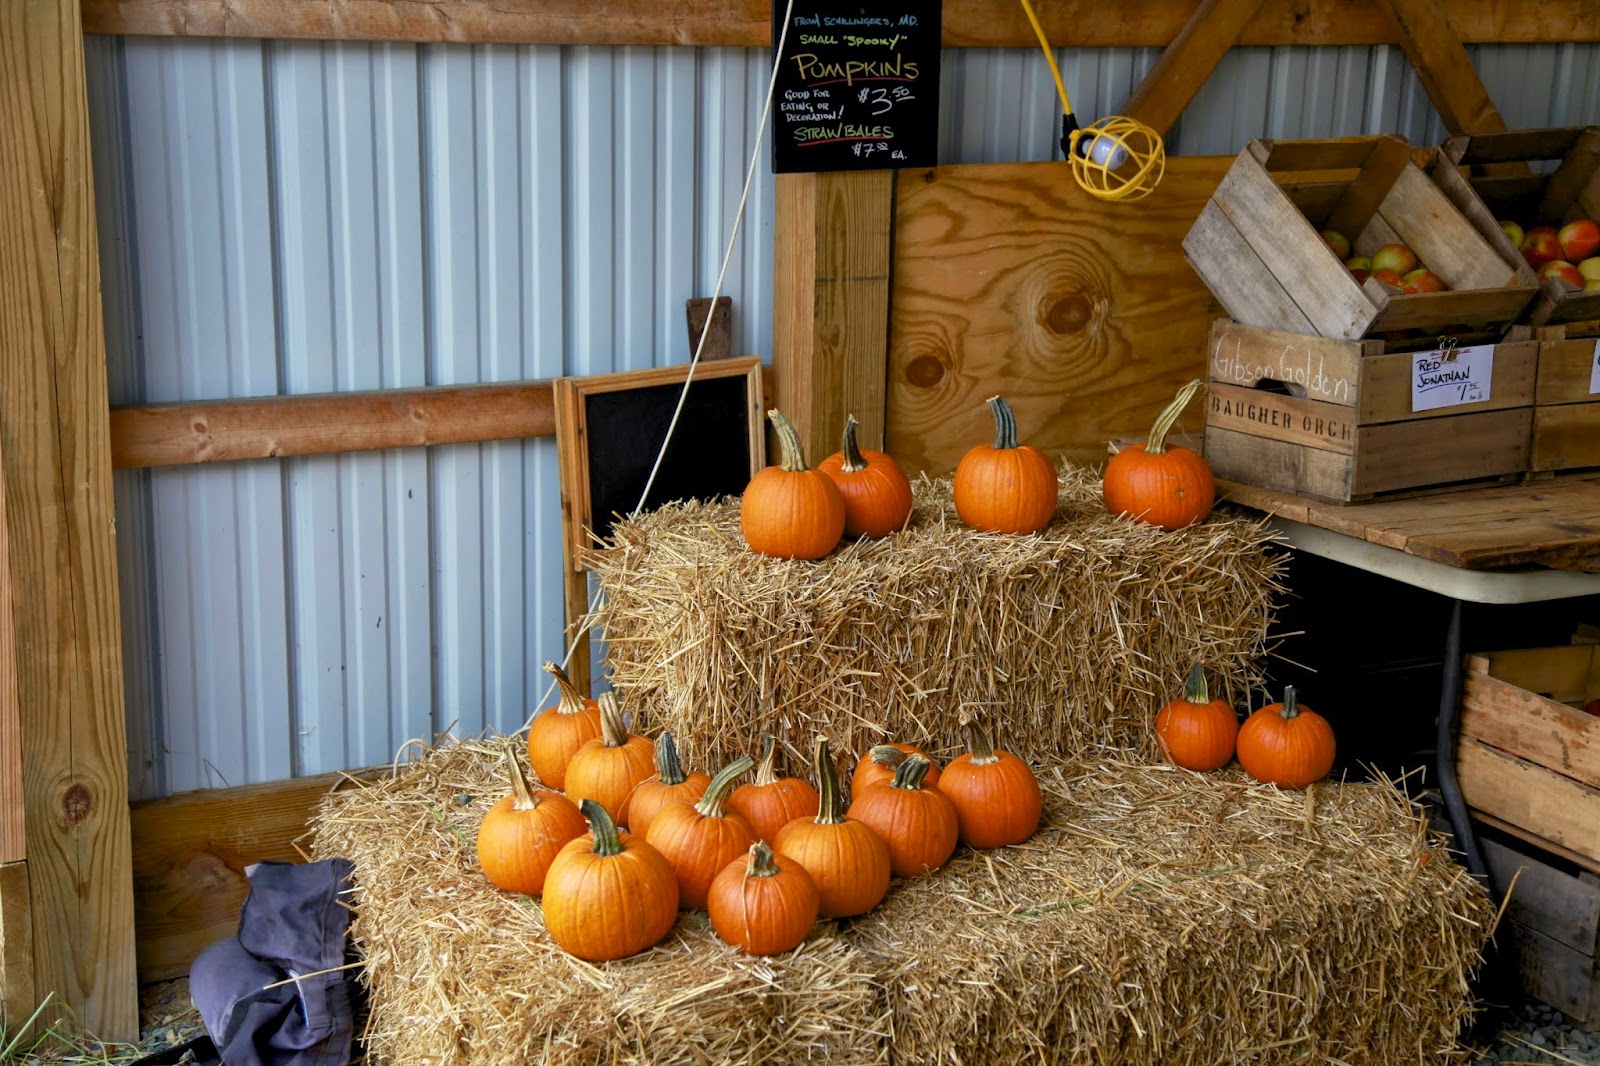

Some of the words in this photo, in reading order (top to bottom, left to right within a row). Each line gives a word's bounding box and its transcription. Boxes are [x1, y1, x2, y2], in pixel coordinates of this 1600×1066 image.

[793, 13, 821, 27] FROM
[800, 34, 838, 45] SMALL
[790, 53, 919, 86] PUMPKINS
[784, 89, 810, 100] GOOD
[813, 89, 830, 98] FOR
[780, 102, 814, 113] EATING
[817, 102, 830, 111] OR
[785, 105, 844, 122] DECORATION!
[793, 122, 842, 141] STRAW
[844, 124, 894, 139] BALES
[1214, 332, 1274, 383] Gibson
[1280, 345, 1348, 401] Golden
[1416, 359, 1441, 372] RED
[1417, 366, 1470, 388] JONATHAN
[1212, 397, 1292, 429] BAUGHER
[1302, 415, 1351, 441] ORCH
